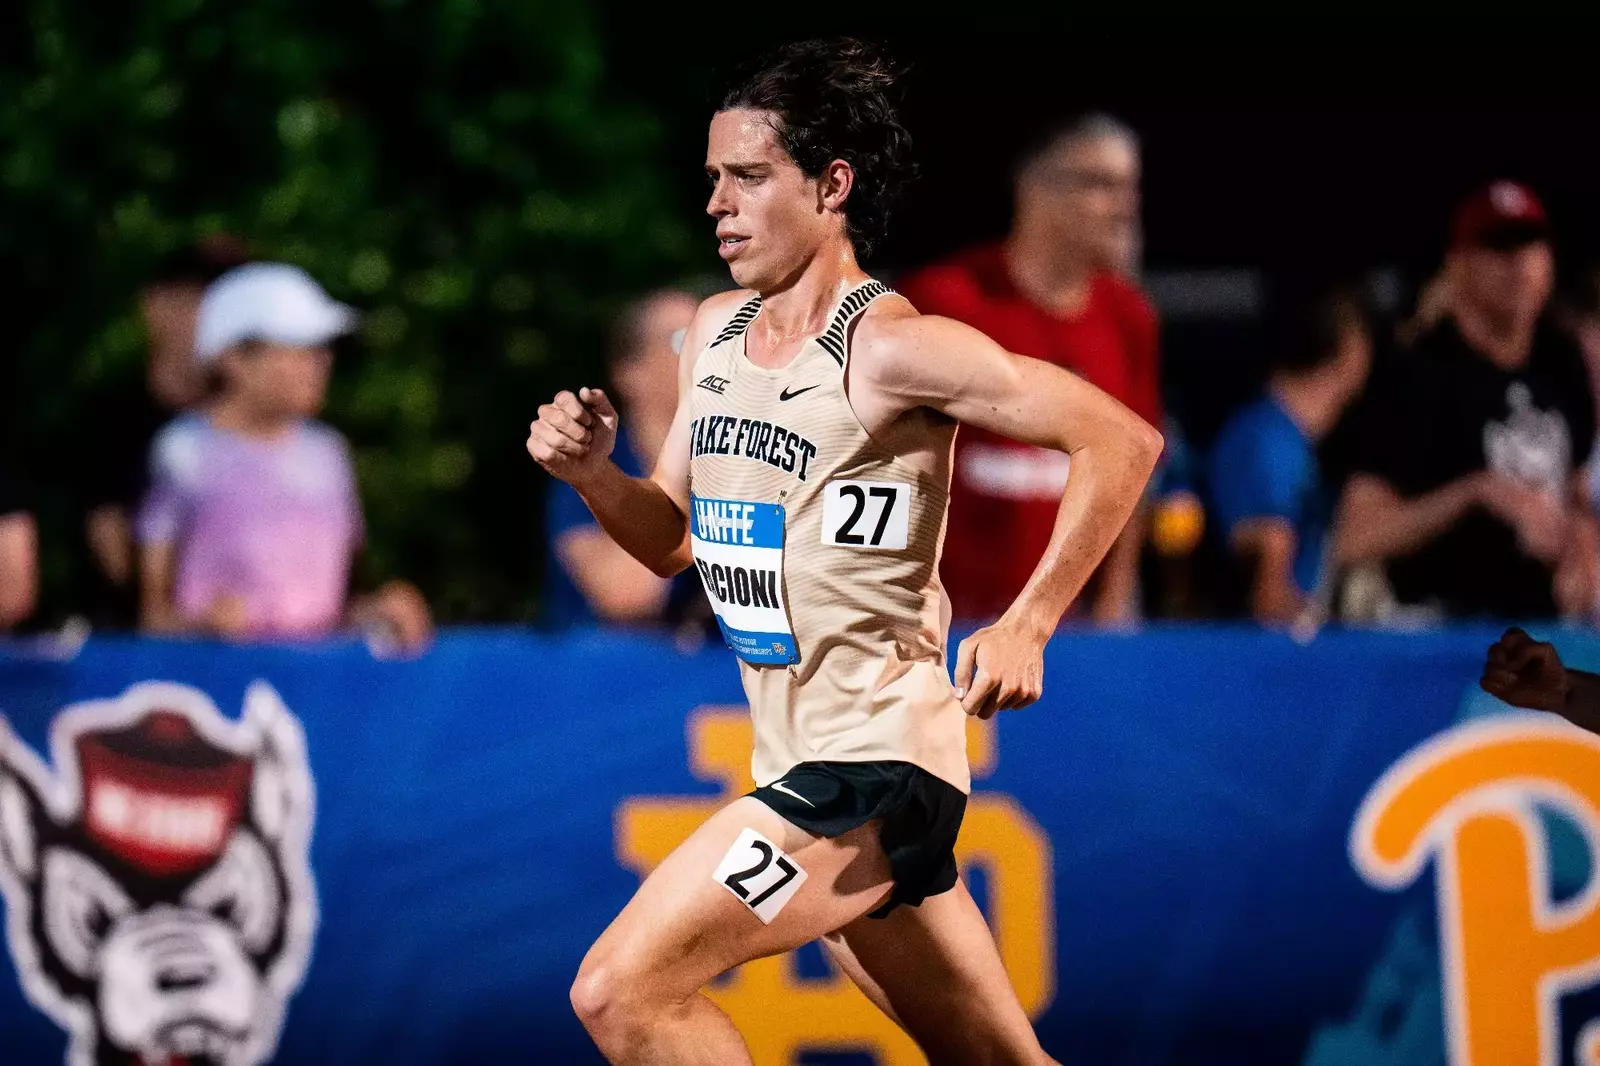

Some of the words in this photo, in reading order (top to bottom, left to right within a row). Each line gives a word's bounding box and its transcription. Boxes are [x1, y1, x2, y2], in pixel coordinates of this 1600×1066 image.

[698, 374, 731, 393] ACC
[733, 418, 817, 482] FOREST
[694, 500, 755, 545] UNITE
[834, 484, 898, 546] 27
[724, 839, 799, 909] 27
